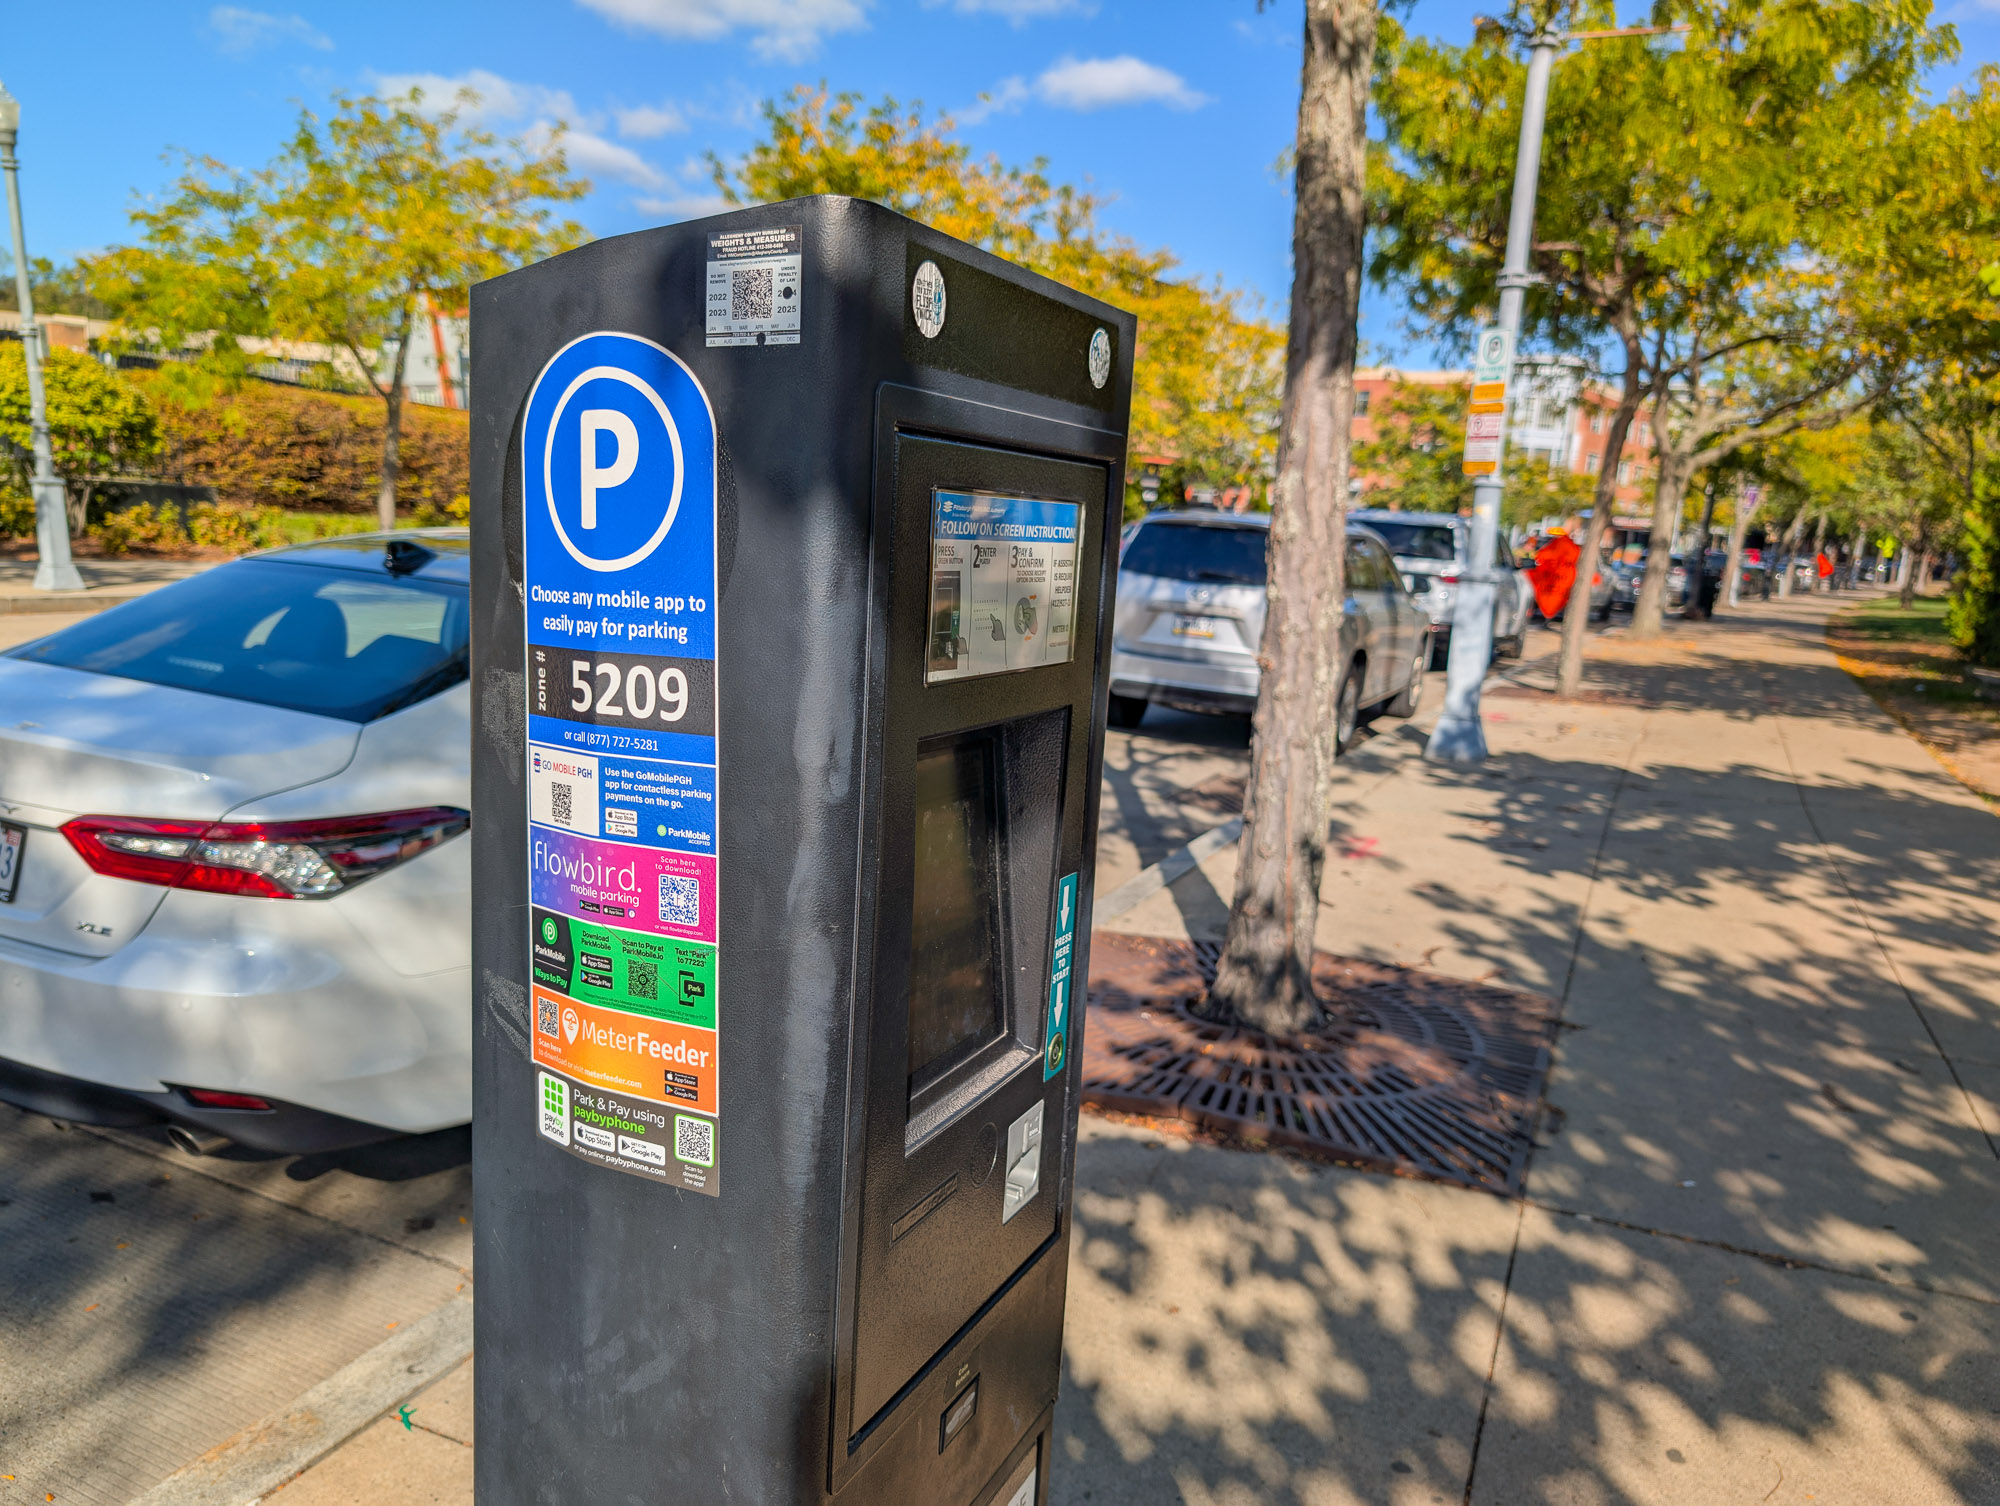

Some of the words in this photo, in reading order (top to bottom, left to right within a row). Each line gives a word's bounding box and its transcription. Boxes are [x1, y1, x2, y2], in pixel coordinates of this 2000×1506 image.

[711, 238, 744, 248] WEIGHTS
[754, 234, 796, 244] MEASURES
[778, 289, 797, 298] 24
[580, 409, 639, 530] P
[941, 521, 978, 536] FOLLOW
[980, 522, 992, 536] ON
[994, 523, 1025, 537] SCREEN
[938, 546, 955, 557] PRESS
[973, 544, 980, 568] 2
[980, 547, 996, 558] ENTER
[1011, 546, 1018, 568] 3
[1018, 548, 1028, 557] PAY
[1029, 548, 1033, 558] &
[1019, 558, 1044, 568] CONFIRM
[532, 585, 569, 604] Choose
[572, 592, 593, 609] any
[597, 590, 650, 609] mobile
[654, 596, 684, 614] app
[689, 595, 706, 612] to
[543, 615, 574, 636] easily
[576, 620, 598, 638] pay
[601, 618, 624, 636] for
[628, 621, 688, 644] parking
[536, 650, 546, 662] #
[537, 668, 546, 711] zone
[572, 660, 688, 722] 5209
[564, 731, 572, 740] or
[573, 732, 586, 742] call
[587, 734, 610, 748] (877)
[612, 736, 658, 751] 727-5281
[542, 760, 552, 770] GO
[553, 762, 576, 776] MOBILE
[577, 767, 592, 779] PGH
[605, 767, 620, 776] Use
[621, 769, 634, 778] the
[636, 771, 692, 785] GoMobilePGH
[605, 780, 620, 789] app
[621, 781, 632, 790] for
[634, 784, 679, 796] contactless
[681, 789, 712, 801] parking
[605, 792, 643, 804] payments
[656, 798, 669, 806] the
[671, 801, 684, 809] go.
[668, 828, 710, 840] ParkMobile
[535, 841, 642, 893] flowbird.
[660, 856, 677, 864] Scan
[680, 858, 696, 867] here
[665, 865, 702, 875] download!
[571, 884, 597, 899] mobile
[600, 890, 639, 908] parking
[76, 920, 112, 937] XLE
[582, 930, 610, 942] Download
[581, 938, 611, 951] ParkMobile
[622, 939, 637, 948] Scan
[646, 943, 657, 952] Pay
[1054, 932, 1072, 948] PRESS
[535, 944, 566, 962] ParkMobile
[622, 947, 664, 960] ParkMobile.io
[675, 948, 688, 956] Text
[1056, 944, 1070, 959] HERE
[1058, 958, 1066, 968] TO
[535, 967, 549, 980] Ways
[550, 973, 556, 982] to
[556, 975, 568, 988] Pay
[588, 977, 601, 986] Google
[1052, 966, 1069, 984] START
[688, 984, 701, 993] Park
[539, 1038, 550, 1050] Scan
[550, 1044, 561, 1054] here
[582, 1020, 709, 1068] MeterFeeder
[544, 1051, 567, 1066] download
[573, 1064, 584, 1073] visit
[584, 1069, 642, 1088] meterfeeder.com
[574, 1089, 595, 1108] Park
[597, 1097, 606, 1110] &
[608, 1100, 630, 1119] Pay
[633, 1110, 665, 1128] using
[544, 1113, 563, 1128] payby
[574, 1105, 645, 1134] paybyphone
[544, 1122, 564, 1138] phone
[585, 1134, 596, 1143] App
[596, 1136, 612, 1147] Store
[580, 1146, 588, 1155] pay
[588, 1149, 605, 1160] online:
[605, 1155, 666, 1176] paybyphone.com
[631, 1147, 650, 1158] Google
[651, 1152, 662, 1160] Play
[682, 1171, 706, 1181] download
